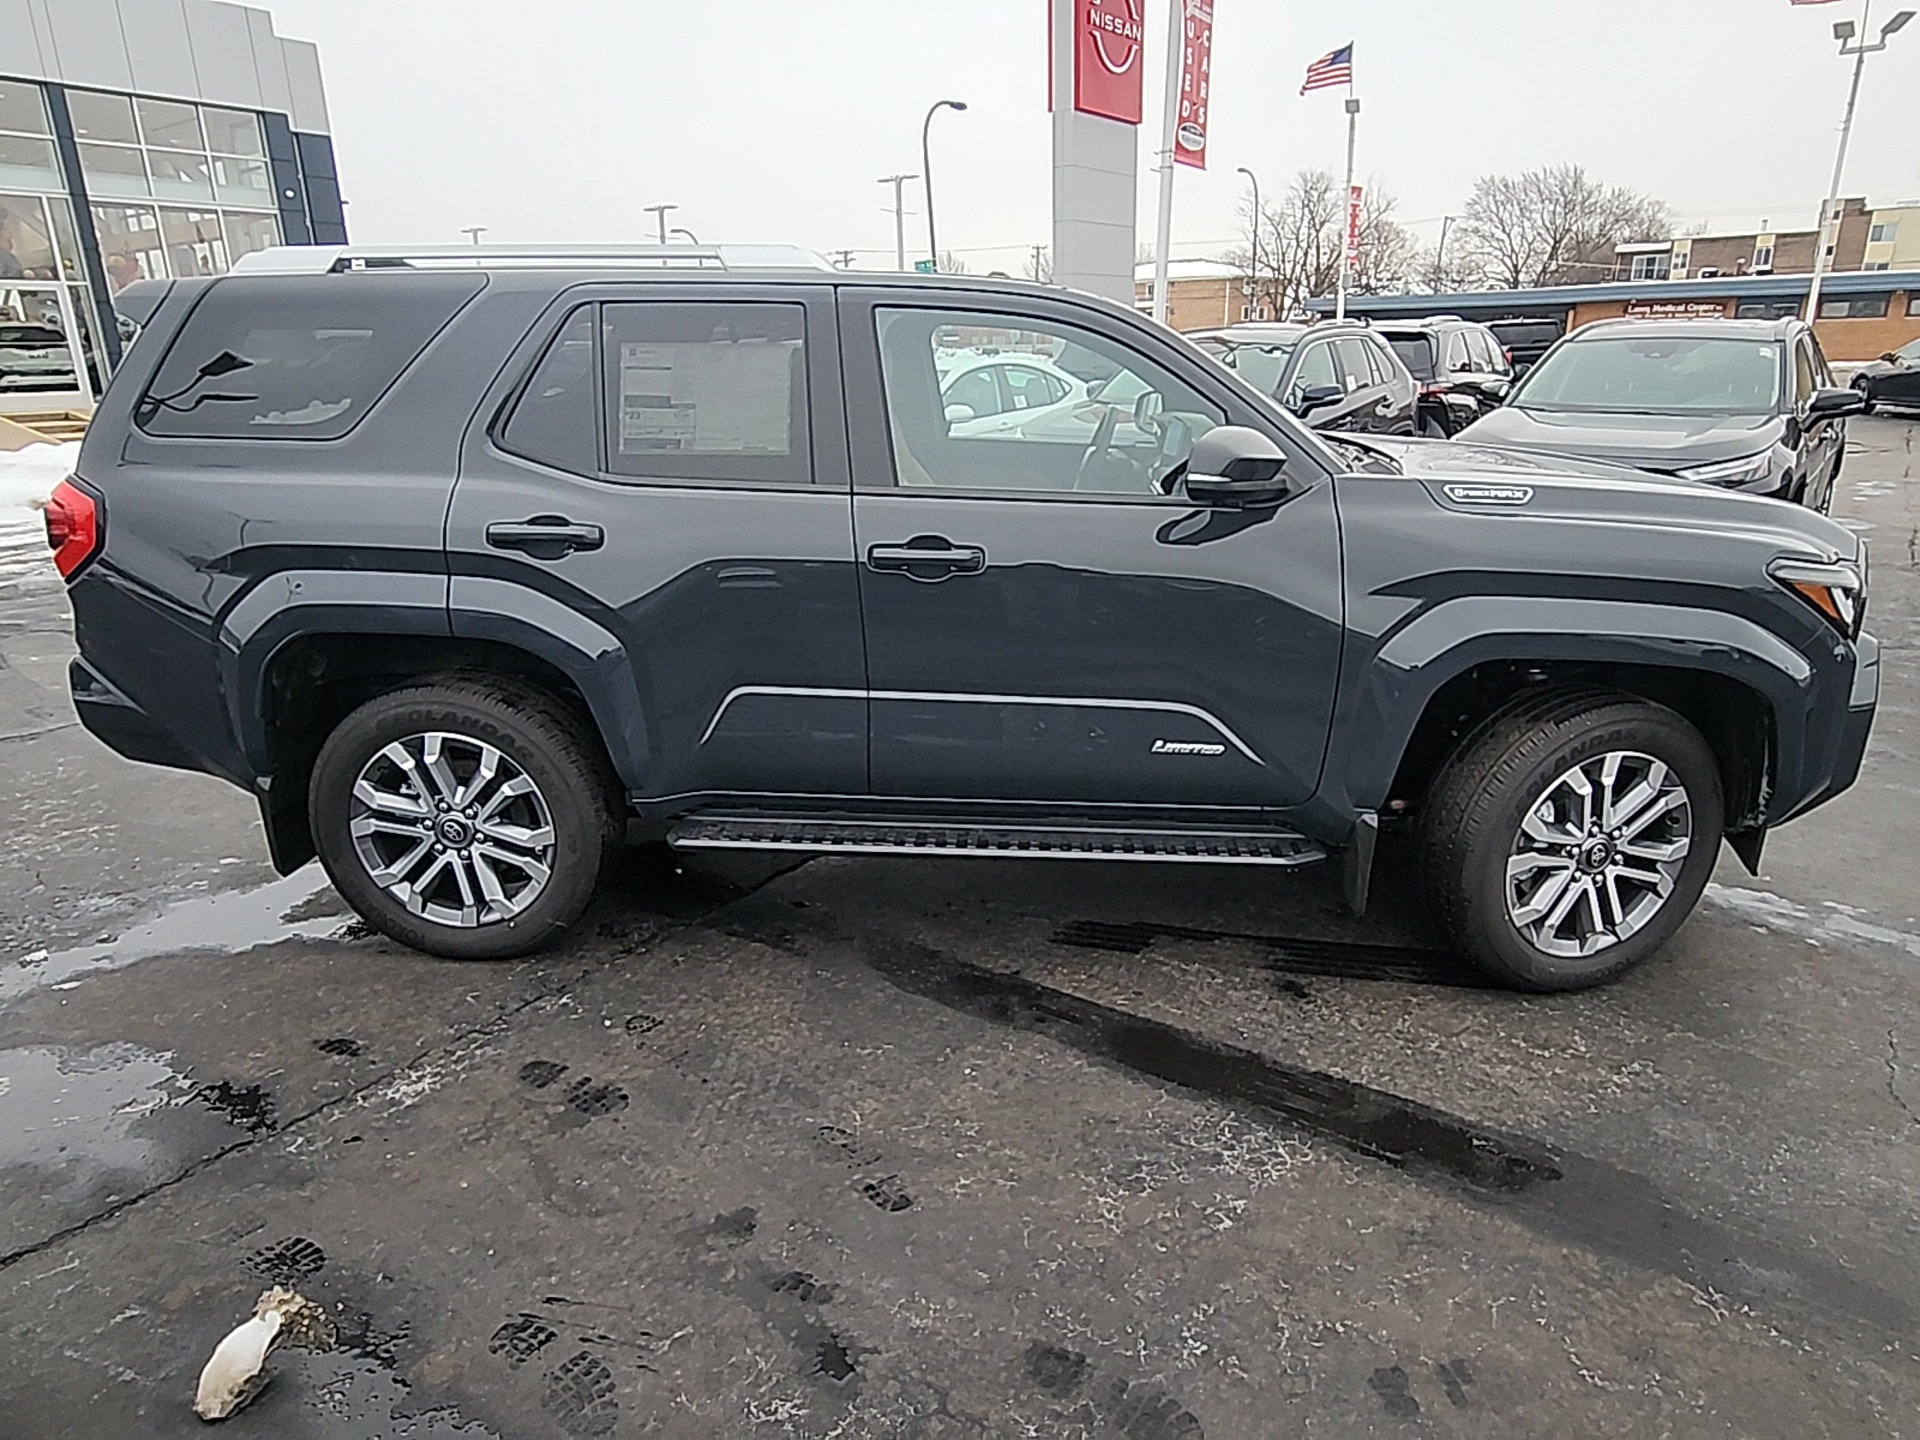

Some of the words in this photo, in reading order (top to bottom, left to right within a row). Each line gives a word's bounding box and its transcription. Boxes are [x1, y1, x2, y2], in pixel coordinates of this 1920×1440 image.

[1090, 8, 1141, 41] NISSAN
[1181, 20, 1194, 118] USED
[1197, 30, 1210, 124] CARS
